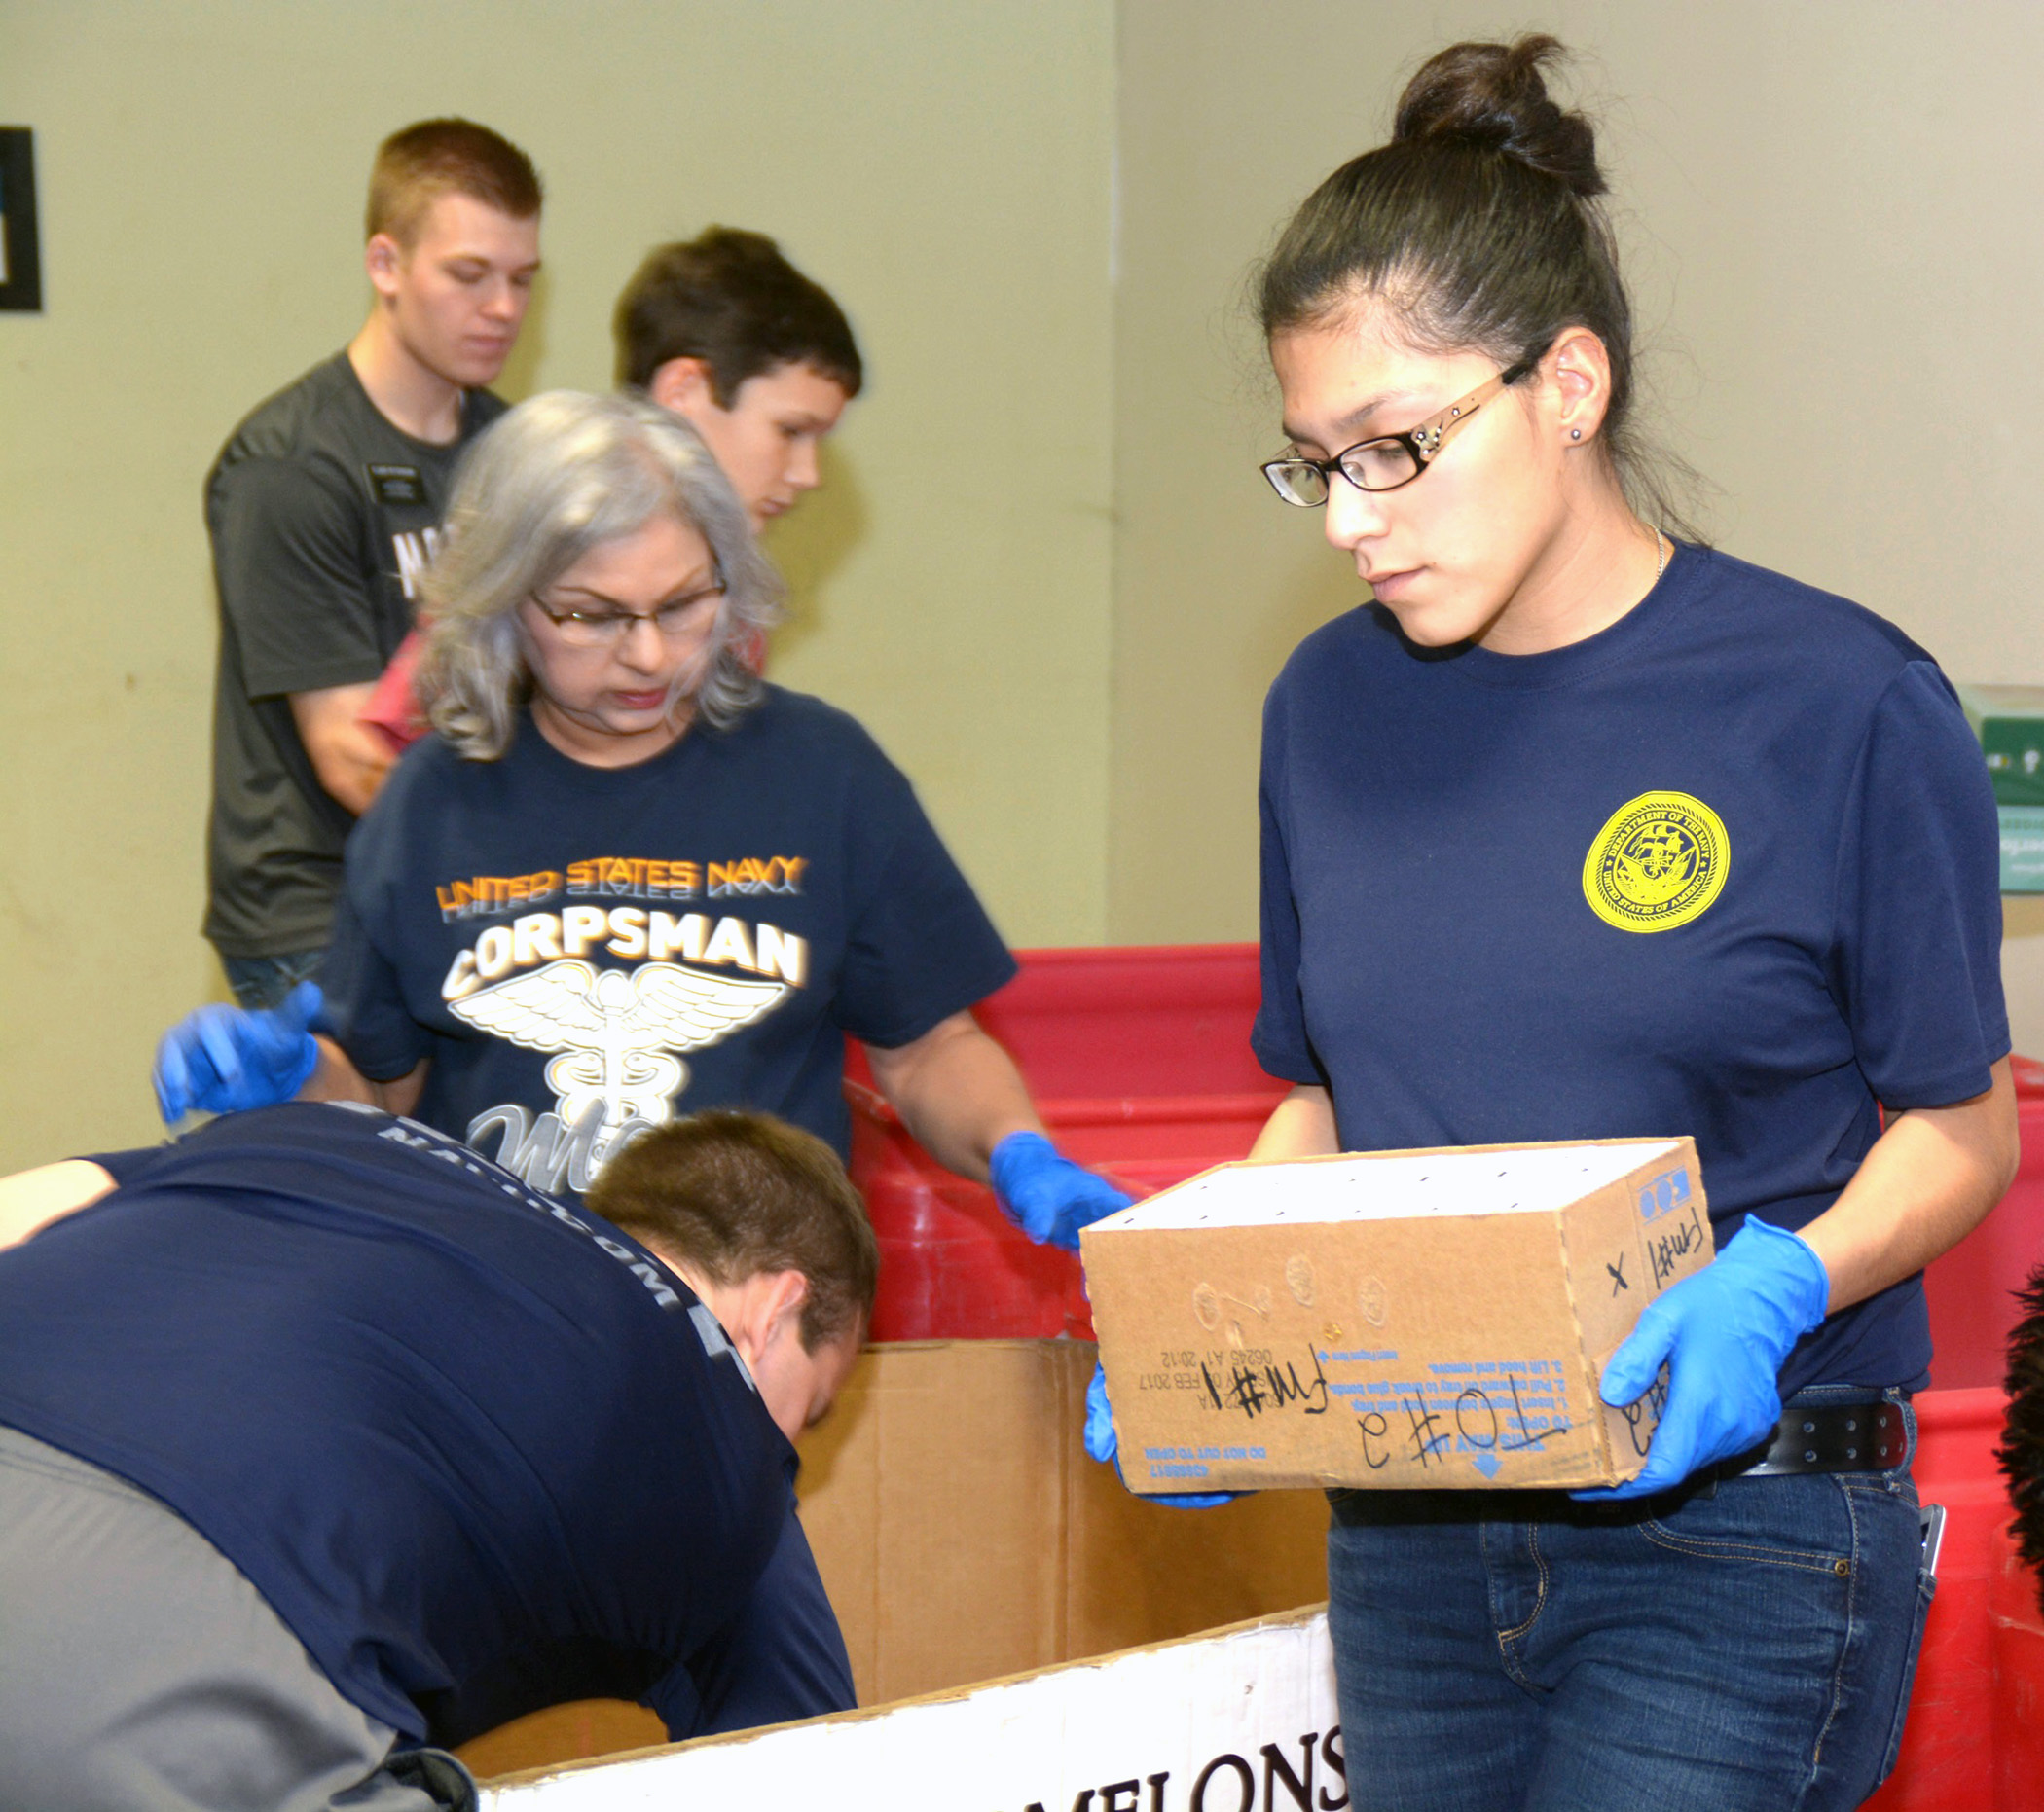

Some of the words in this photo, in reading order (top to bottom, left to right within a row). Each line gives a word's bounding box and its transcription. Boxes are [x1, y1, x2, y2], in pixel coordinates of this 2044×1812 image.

[1610, 811, 1667, 857] DEPARTMENT
[1668, 812, 1684, 823] OF
[1683, 817, 1700, 833] THE
[1696, 829, 1710, 859] NAVY
[436, 870, 563, 913] UNITED
[566, 853, 703, 889] STATES
[708, 854, 807, 888] NAVY
[1603, 871, 1622, 901] UNITED
[1617, 897, 1655, 915] STATES
[1655, 903, 1669, 913] OF
[1670, 871, 1708, 909] AMERICA
[442, 905, 807, 1001] CORPSMAN
[1159, 1351, 1196, 1369] 20:12
[1229, 1349, 1273, 1366] 06245
[1474, 1362, 1496, 1375] and
[1529, 1360, 1549, 1374] Lift
[1138, 1373, 1171, 1391] 2017
[1172, 1372, 1201, 1390] FEB
[1529, 1379, 1552, 1393] Pull
[1521, 1397, 1556, 1411] Insert
[1551, 1415, 1573, 1430] TO
[1455, 1434, 1497, 1453] WAY
[1500, 1433, 1546, 1452] THIS
[1144, 1447, 1176, 1461] OPEN
[1177, 1447, 1195, 1460] TO
[1197, 1447, 1221, 1460] CUT
[1223, 1448, 1247, 1460] NOT
[1249, 1447, 1266, 1460] DO
